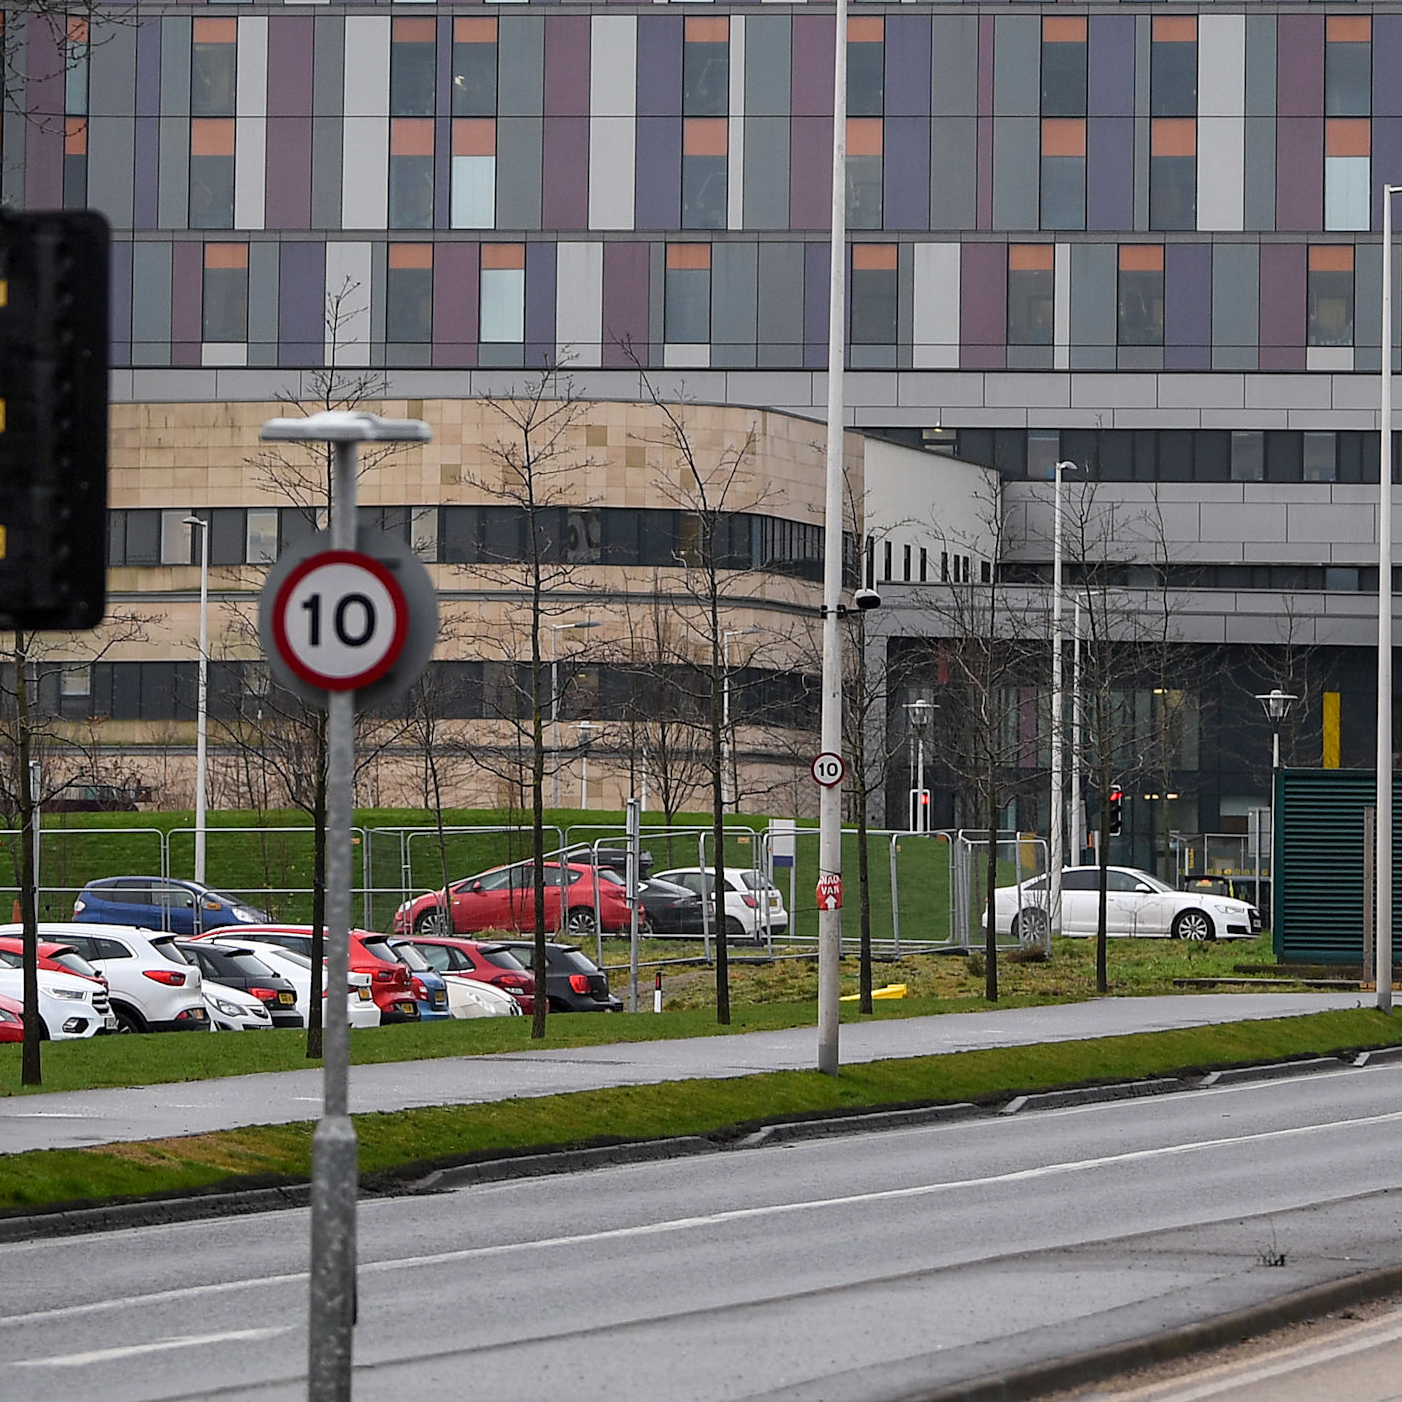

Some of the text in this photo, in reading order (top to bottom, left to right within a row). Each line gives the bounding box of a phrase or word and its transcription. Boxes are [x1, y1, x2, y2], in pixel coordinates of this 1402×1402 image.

[301, 593, 376, 647] 10
[819, 762, 838, 777] 10
[821, 885, 840, 896] VAN
